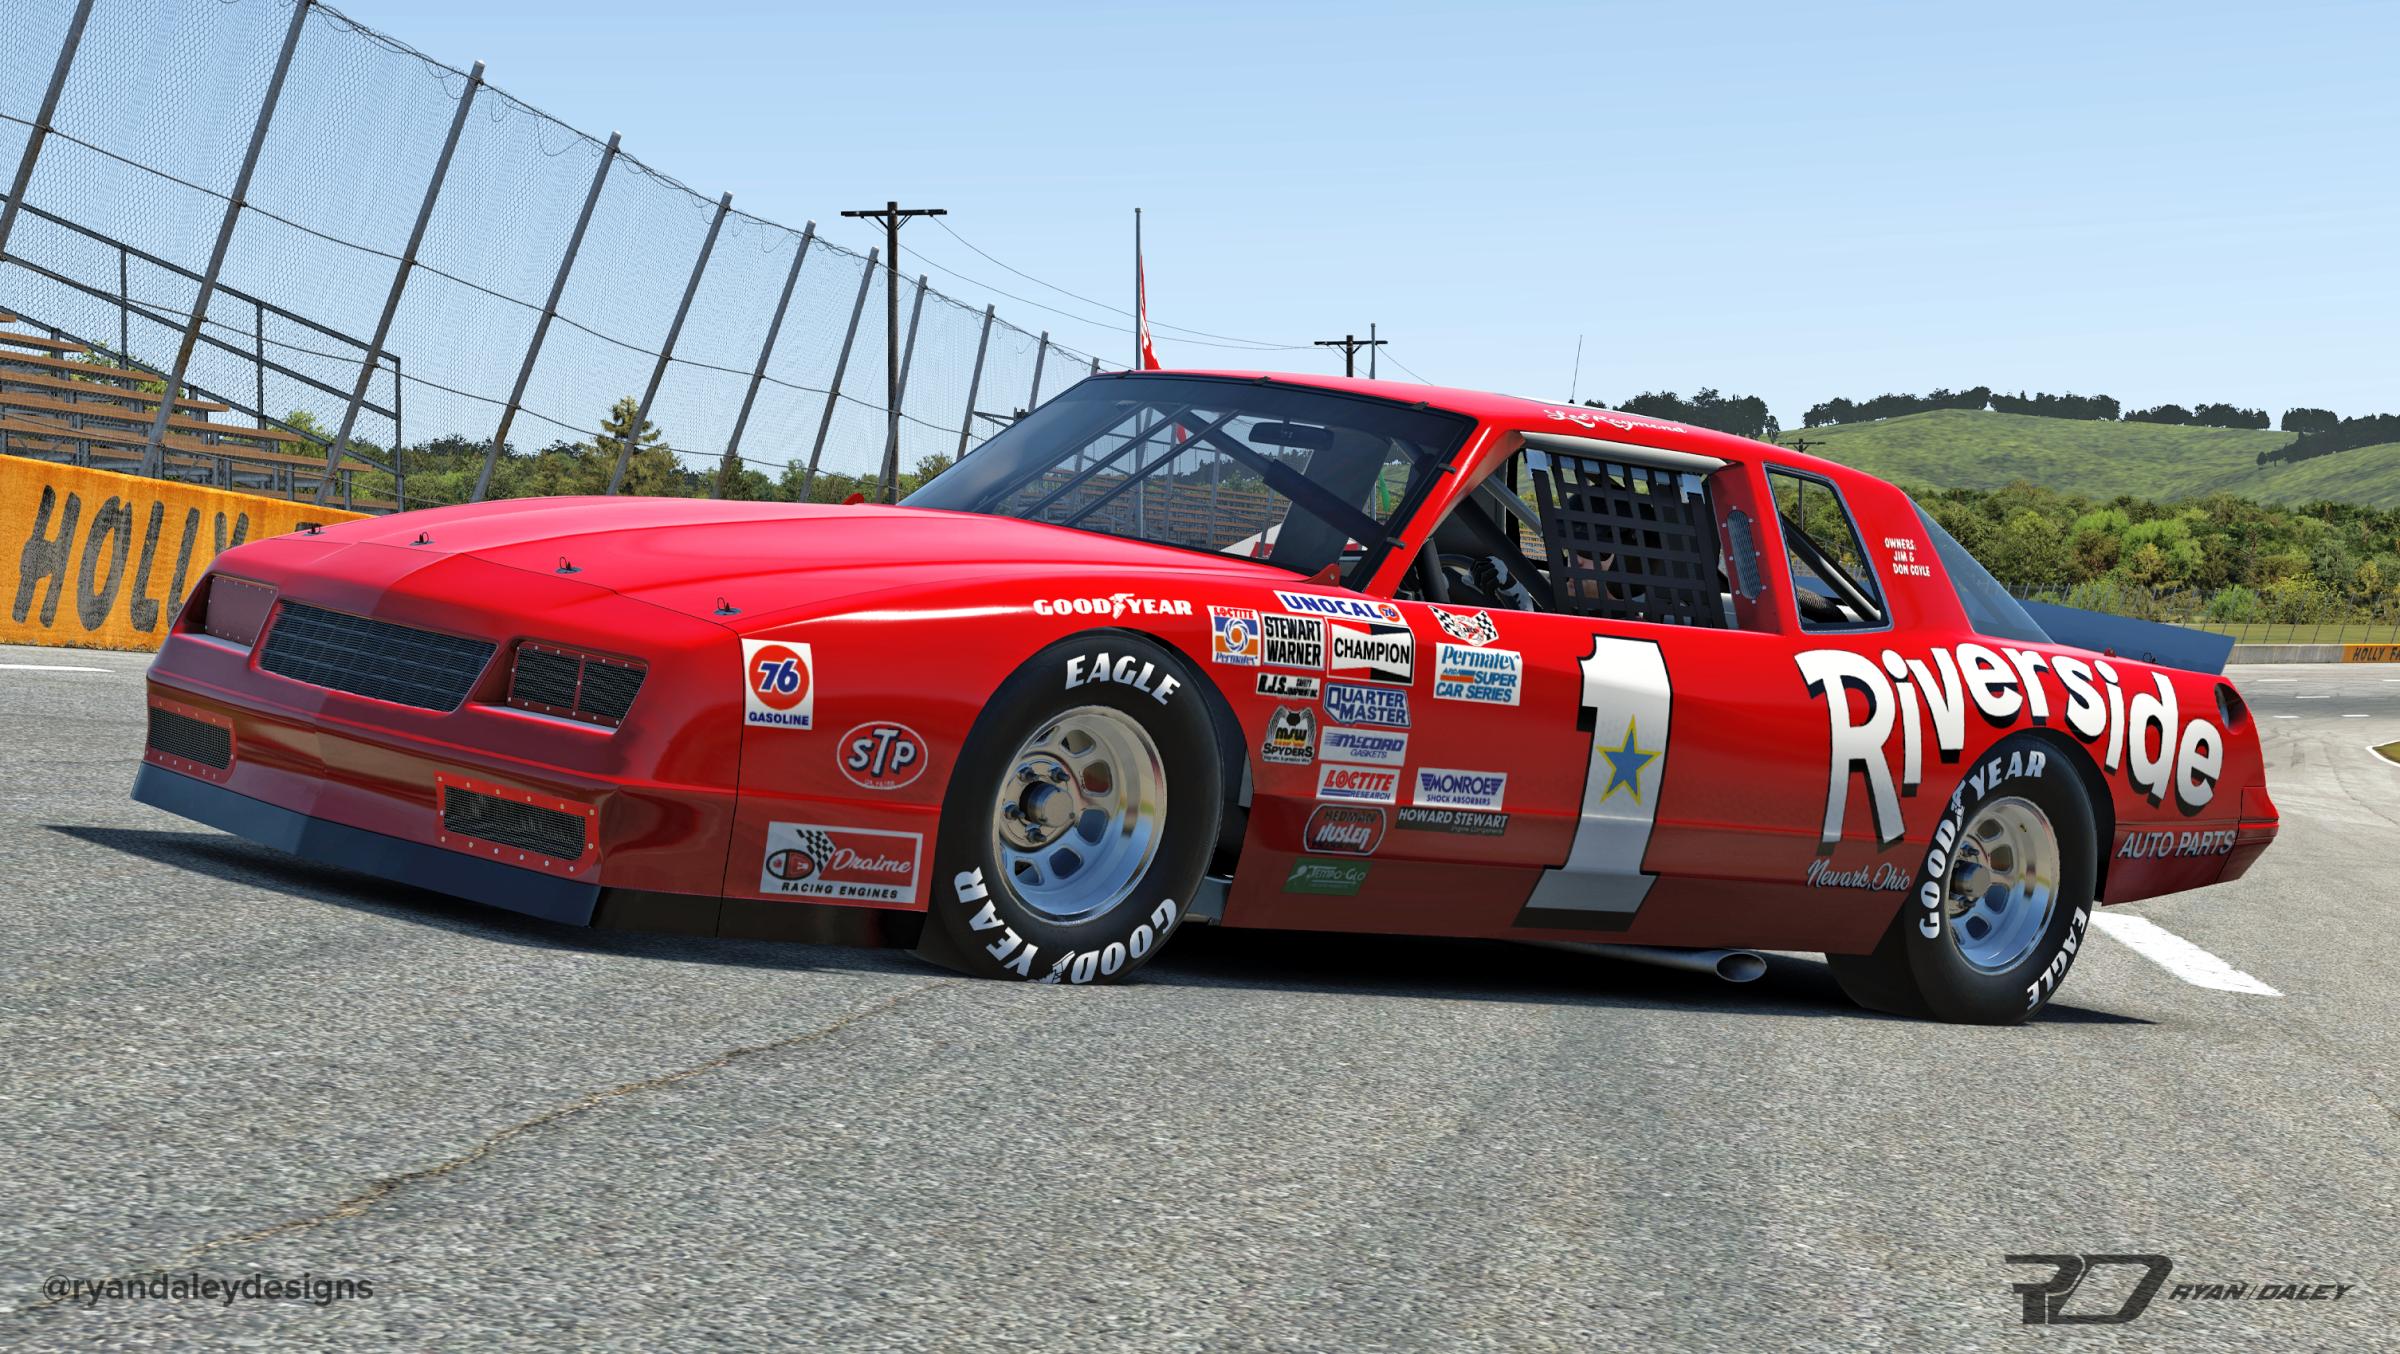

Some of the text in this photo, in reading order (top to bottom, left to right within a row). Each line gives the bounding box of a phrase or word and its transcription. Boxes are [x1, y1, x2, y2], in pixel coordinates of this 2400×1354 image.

[1893, 550, 1908, 562] JIM
[1892, 562, 1931, 577] DON COYLE
[1213, 607, 1254, 620] LOCTITE
[1280, 594, 1396, 619] UNOCAL 76
[1264, 615, 1322, 642] STEWART
[1266, 639, 1322, 667] WARNER
[1334, 637, 1411, 664] CHAMPION
[1441, 645, 1520, 671] Permatex
[2352, 647, 2385, 661] HOLLY
[757, 657, 800, 695] 76
[1065, 652, 1181, 705] EAGLE
[1474, 671, 1517, 687] SUPER
[1327, 686, 1404, 710] QUARTER
[1436, 682, 1512, 703] CAR SERIES
[749, 711, 809, 726] GASOLINE
[1340, 703, 1406, 724] MASTER
[848, 728, 917, 777] STP
[1263, 742, 1314, 758] SPYDERS
[1350, 749, 1388, 760] GASKETS
[1794, 643, 2224, 854] Riverside
[1324, 769, 1395, 791] LOCTITE
[1428, 774, 1492, 795] MONROE
[1518, 634, 1673, 924] 1
[1350, 790, 1391, 800] RESEARCH
[1426, 794, 1450, 803] SHOCK
[1398, 808, 1508, 829] HOWARD STEWART
[2117, 830, 2236, 858] AUTO PARTS
[833, 848, 912, 873] Draime
[1872, 862, 1910, 890] Ohio
[782, 882, 898, 899] RACING ENGINES
[2026, 905, 2088, 1011] EAGLE
